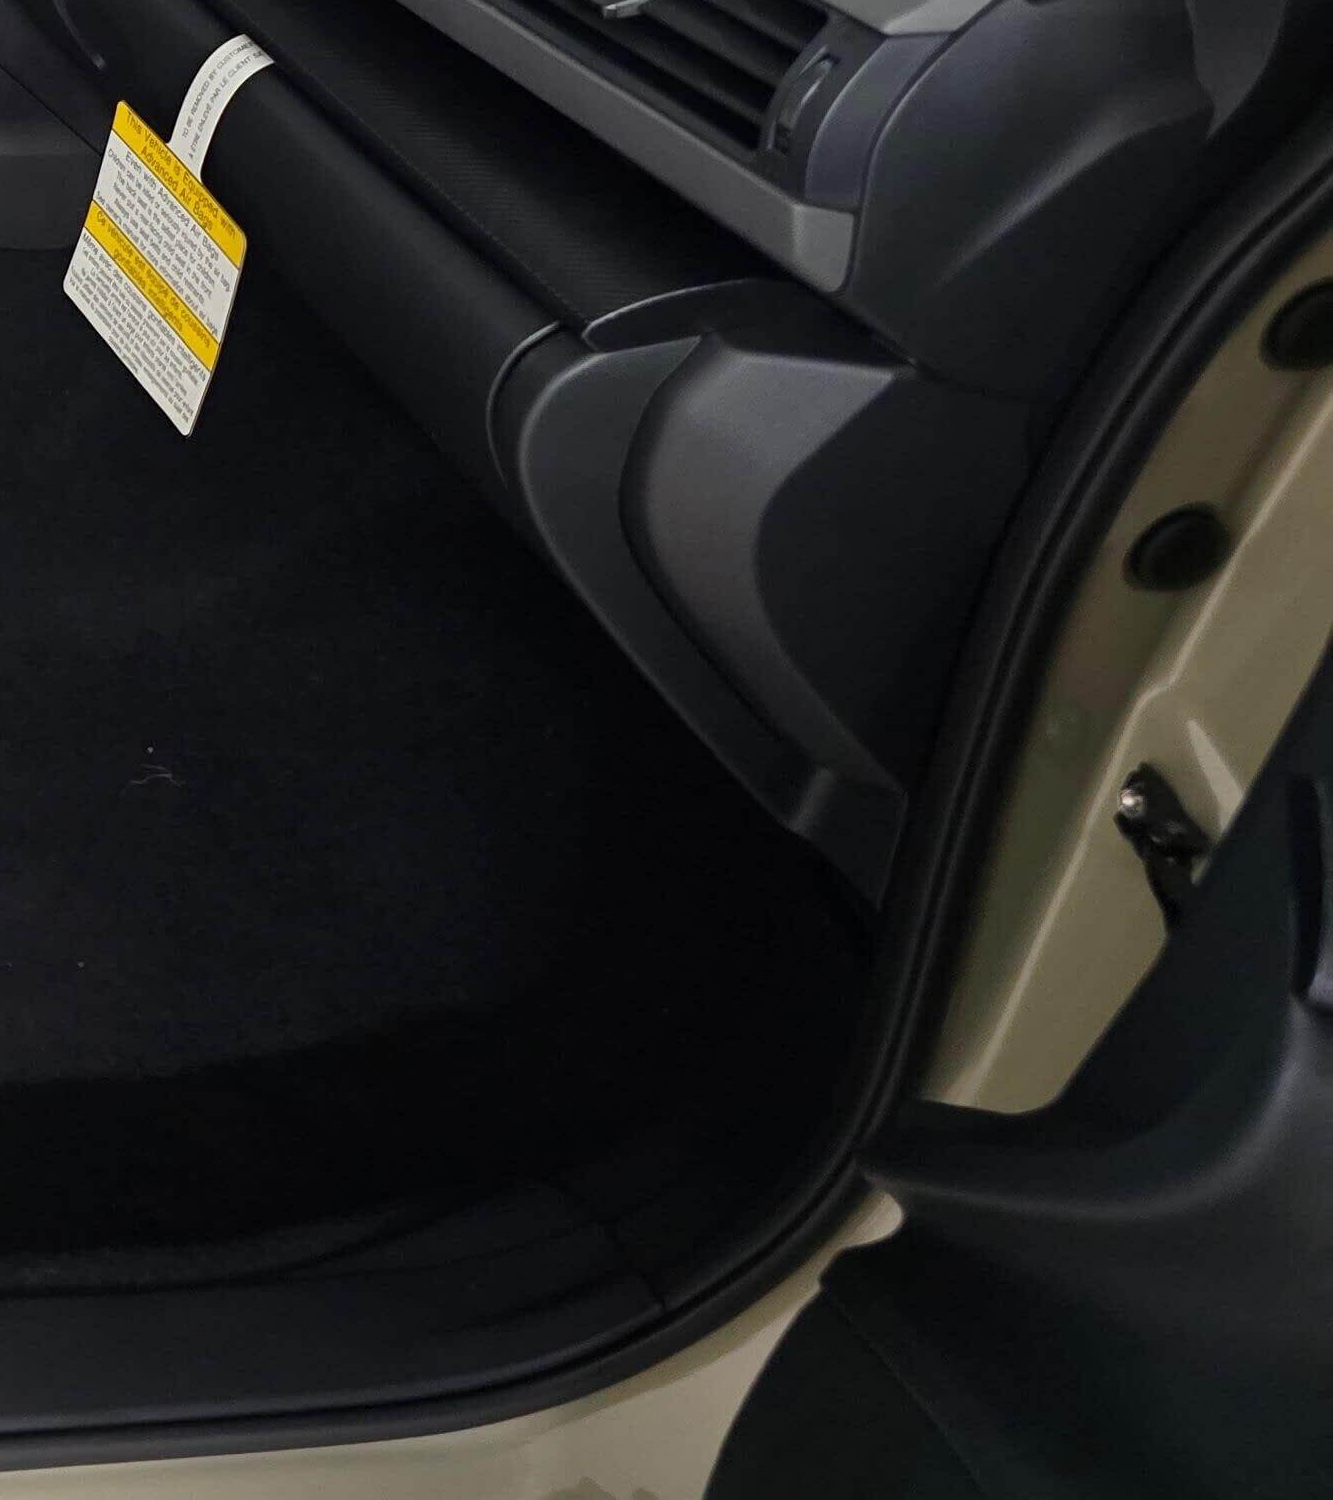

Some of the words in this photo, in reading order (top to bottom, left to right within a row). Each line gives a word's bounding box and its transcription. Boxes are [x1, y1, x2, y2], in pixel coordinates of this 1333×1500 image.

[191, 81, 211, 117] REMOVED
[209, 68, 218, 81] BY
[220, 77, 229, 89] LE
[228, 57, 252, 77] CLIENT
[124, 151, 142, 175] Even
[143, 171, 157, 191] with
[156, 186, 189, 227] Advanced
[189, 222, 201, 240] Air
[201, 235, 220, 263] Bags
[125, 111, 142, 135] This
[143, 130, 172, 167] Vehicle
[172, 162, 180, 177] is
[181, 172, 218, 219] Equipped
[219, 214, 236, 239] with
[140, 145, 178, 192] Advanced
[178, 187, 191, 206] Air
[191, 201, 213, 233] Bags
[95, 210, 107, 228] Ce
[169, 292, 180, 310] de
